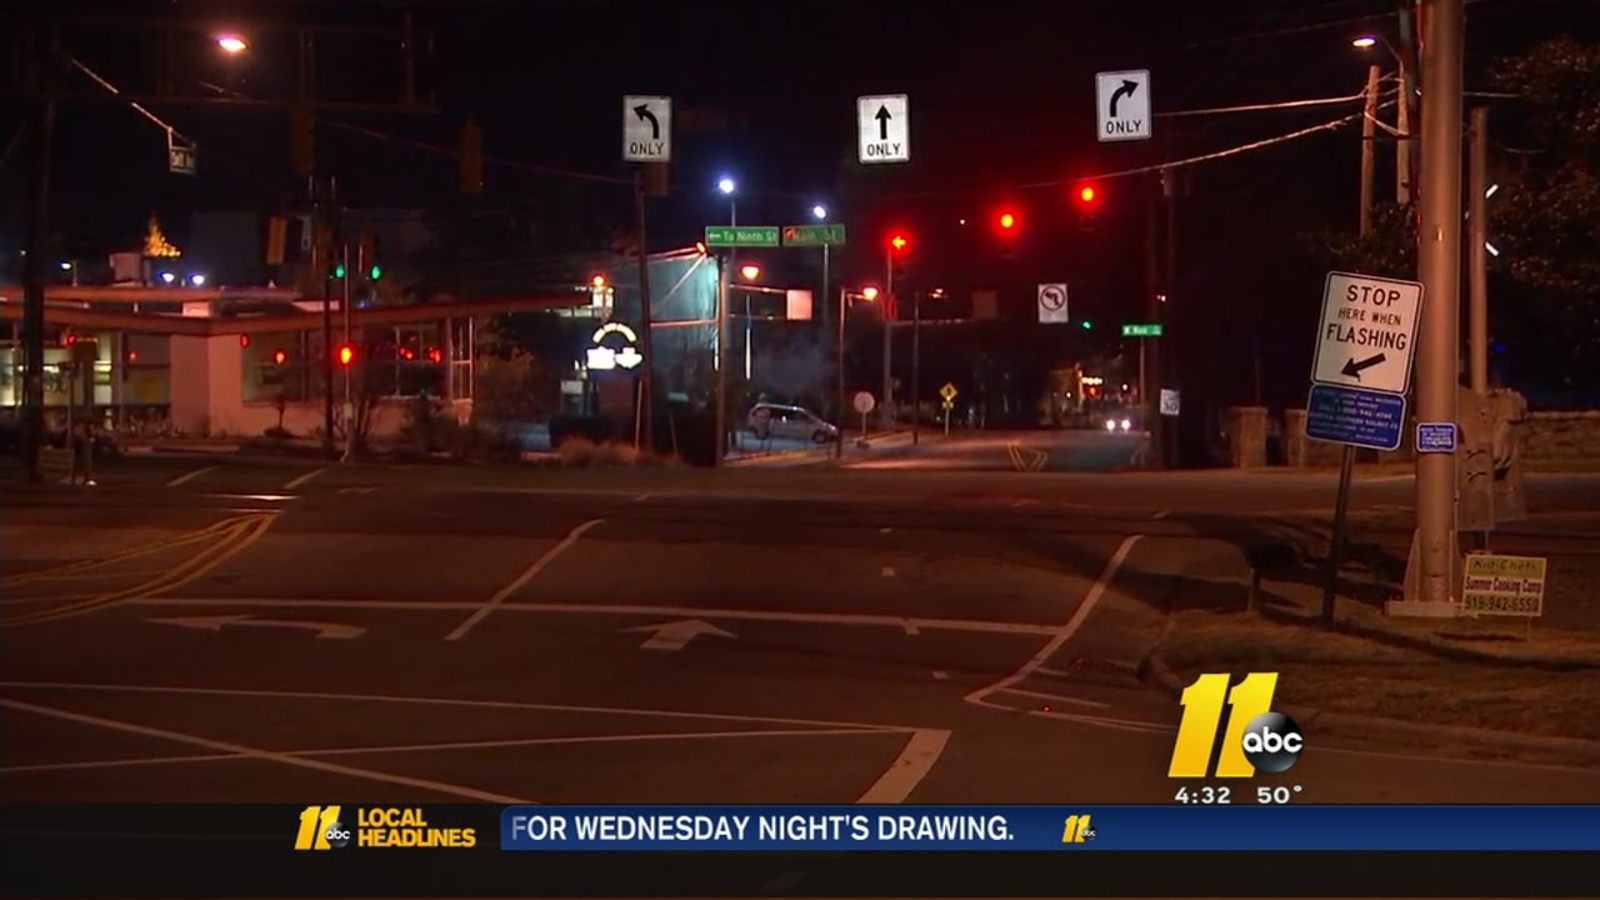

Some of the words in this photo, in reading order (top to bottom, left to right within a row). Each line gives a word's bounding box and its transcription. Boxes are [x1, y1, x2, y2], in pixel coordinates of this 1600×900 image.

[1106, 120, 1142, 134] ONLY
[630, 142, 665, 155] ONLY
[867, 143, 901, 156] ONLY
[722, 231, 735, 241] To
[1346, 284, 1401, 307] STOP
[1338, 307, 1366, 321] HERE
[1371, 311, 1402, 326] WHEN
[1326, 323, 1407, 350] FLASHING
